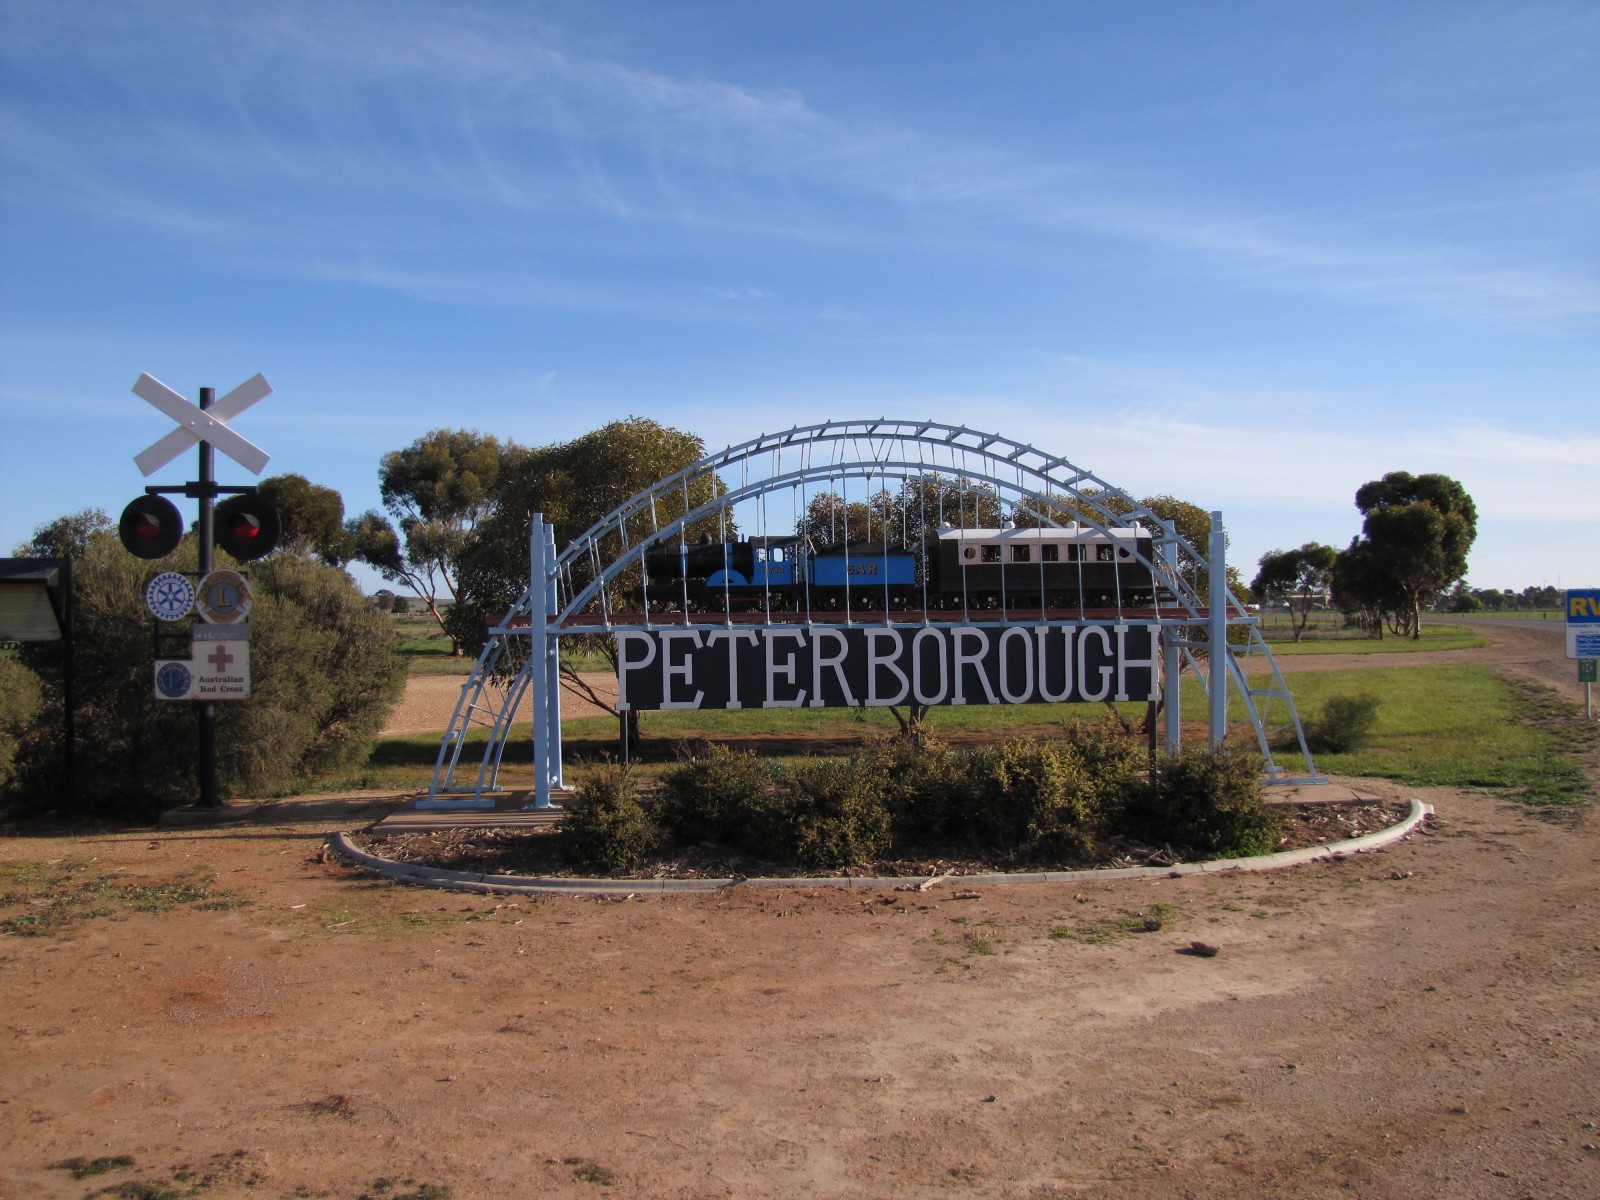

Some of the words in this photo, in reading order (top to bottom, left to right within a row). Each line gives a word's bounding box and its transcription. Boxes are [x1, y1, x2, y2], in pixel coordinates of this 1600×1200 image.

[216, 587, 232, 608] L
[615, 625, 1162, 711] PETERBOROUGH
[220, 685, 244, 693] Cross
